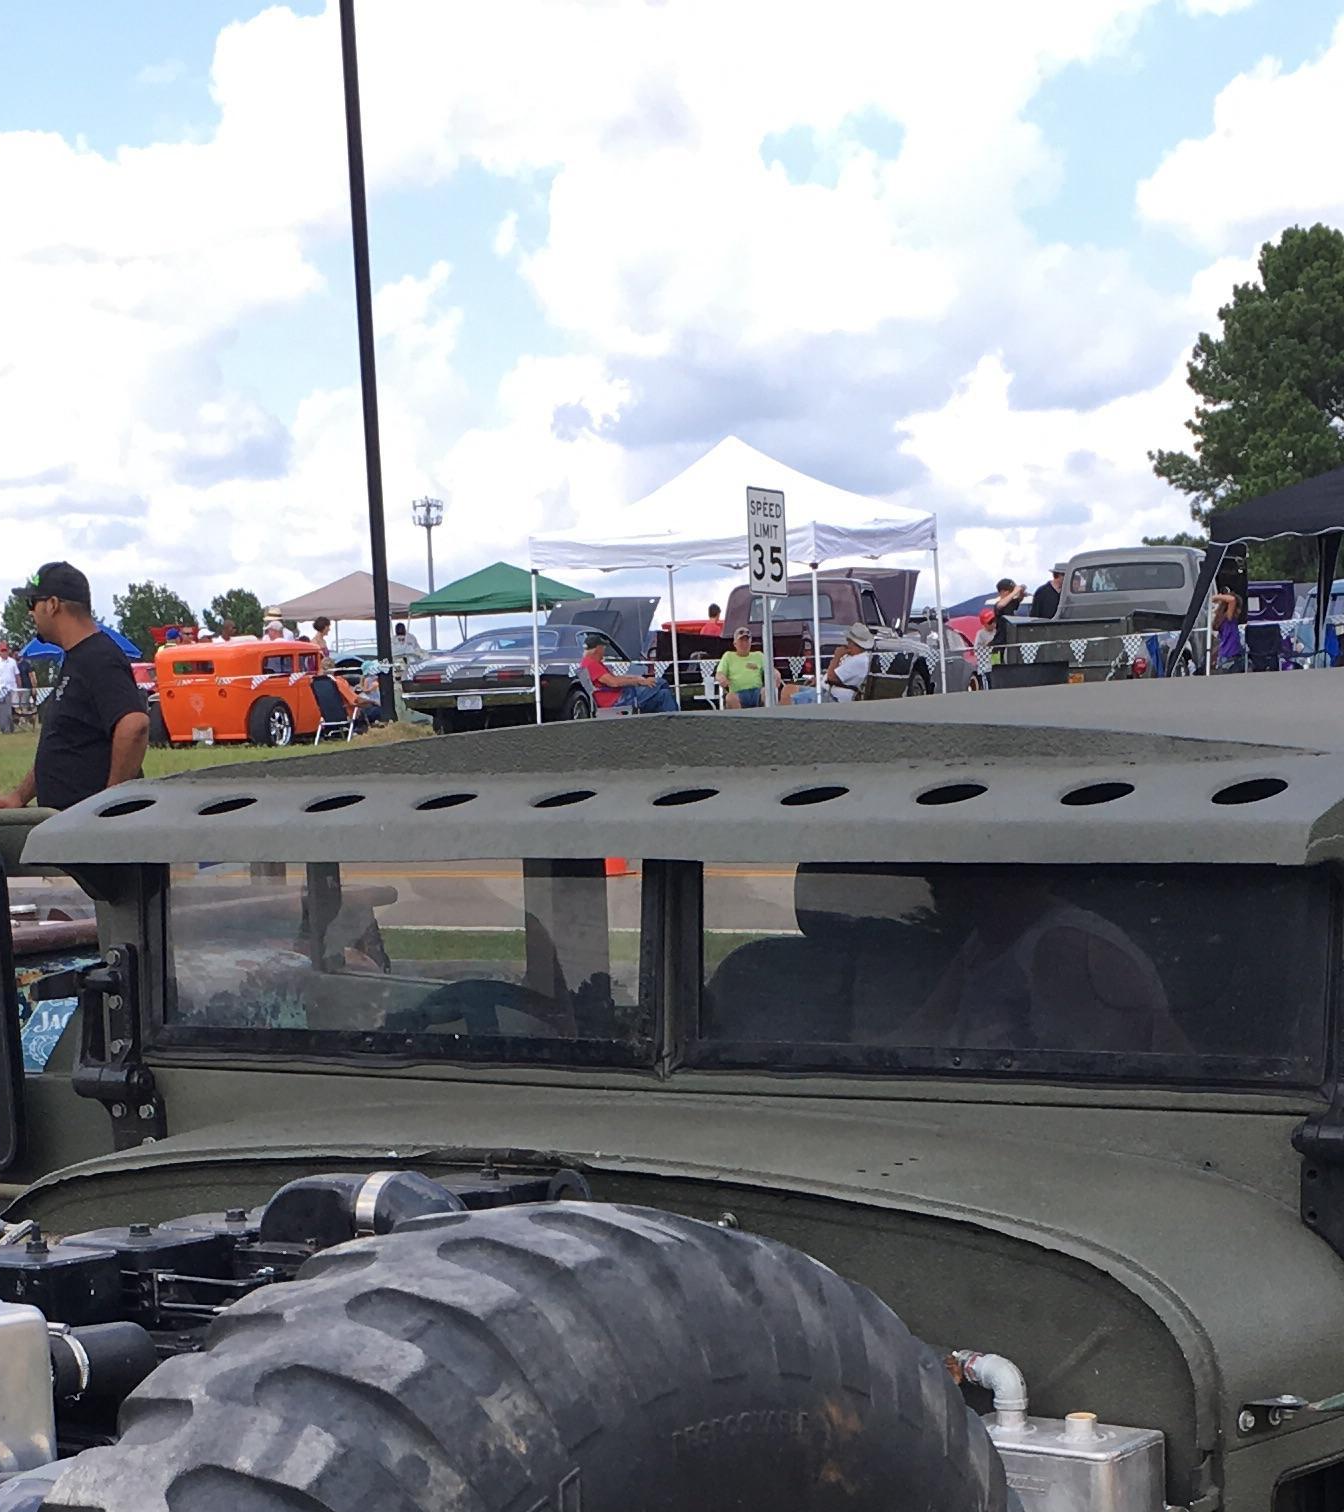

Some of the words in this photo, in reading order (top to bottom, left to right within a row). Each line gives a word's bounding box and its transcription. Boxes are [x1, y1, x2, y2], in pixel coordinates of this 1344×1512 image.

[750, 500, 782, 519] SPEED
[754, 522, 778, 540] LIMIT
[752, 543, 784, 583] 35
